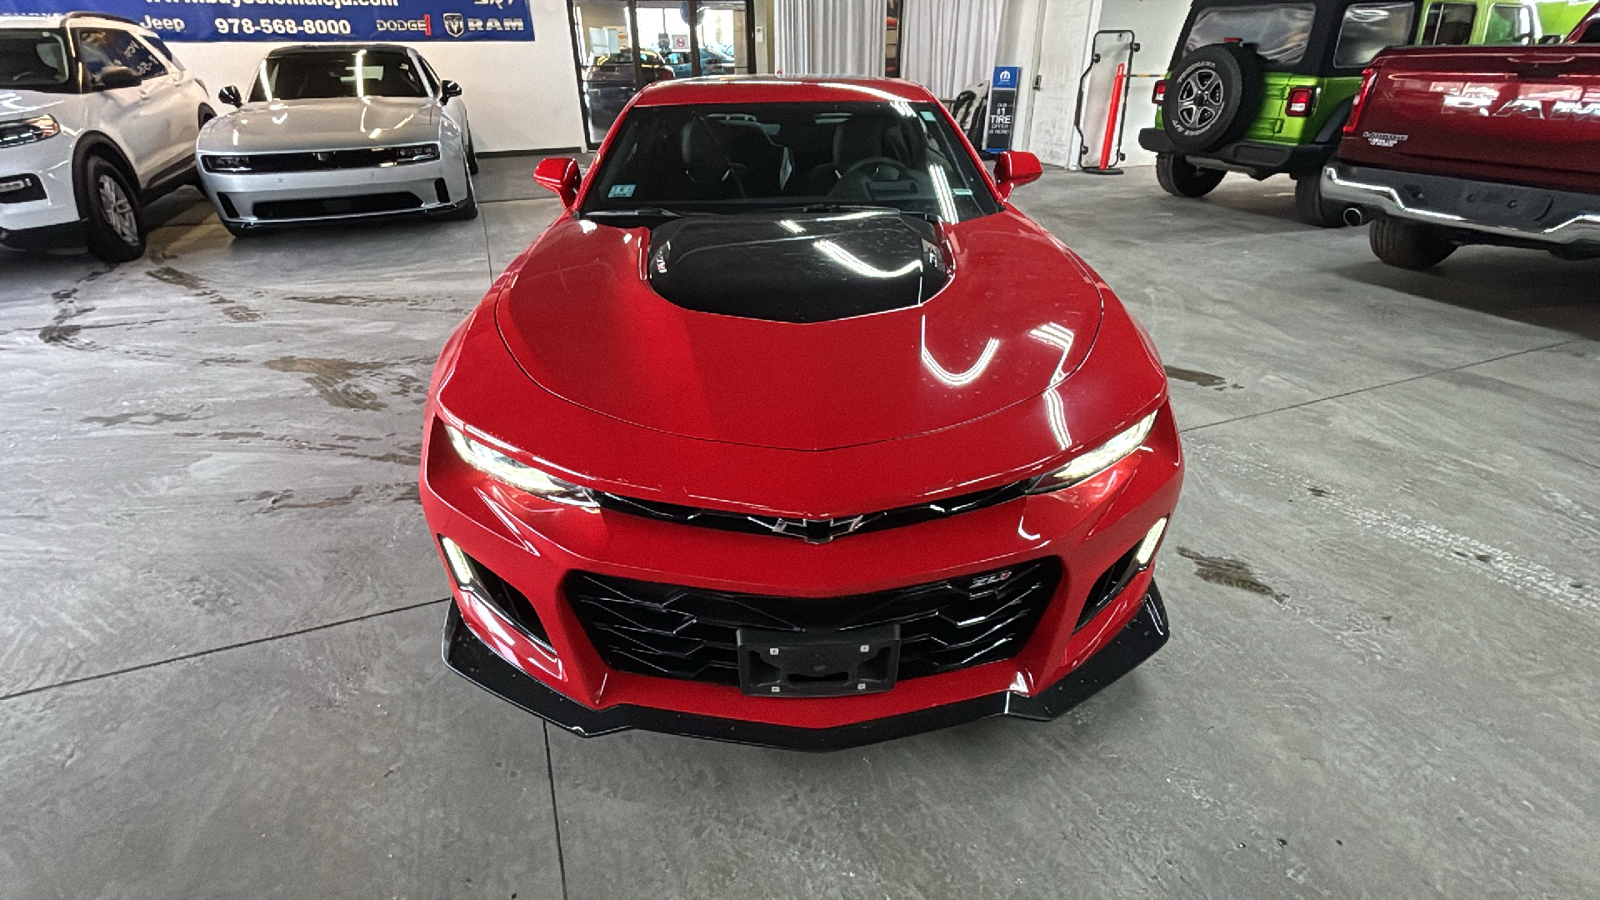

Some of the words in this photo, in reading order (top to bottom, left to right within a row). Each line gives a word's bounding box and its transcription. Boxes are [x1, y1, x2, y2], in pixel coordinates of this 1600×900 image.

[140, 15, 186, 32] Jeep
[214, 18, 351, 34] 978-568-8000
[376, 19, 427, 31] DODGE
[467, 18, 524, 31] RAM
[1441, 94, 1600, 122] RAM
[991, 115, 1011, 123] TIRE
[969, 571, 1012, 588] ZL1
